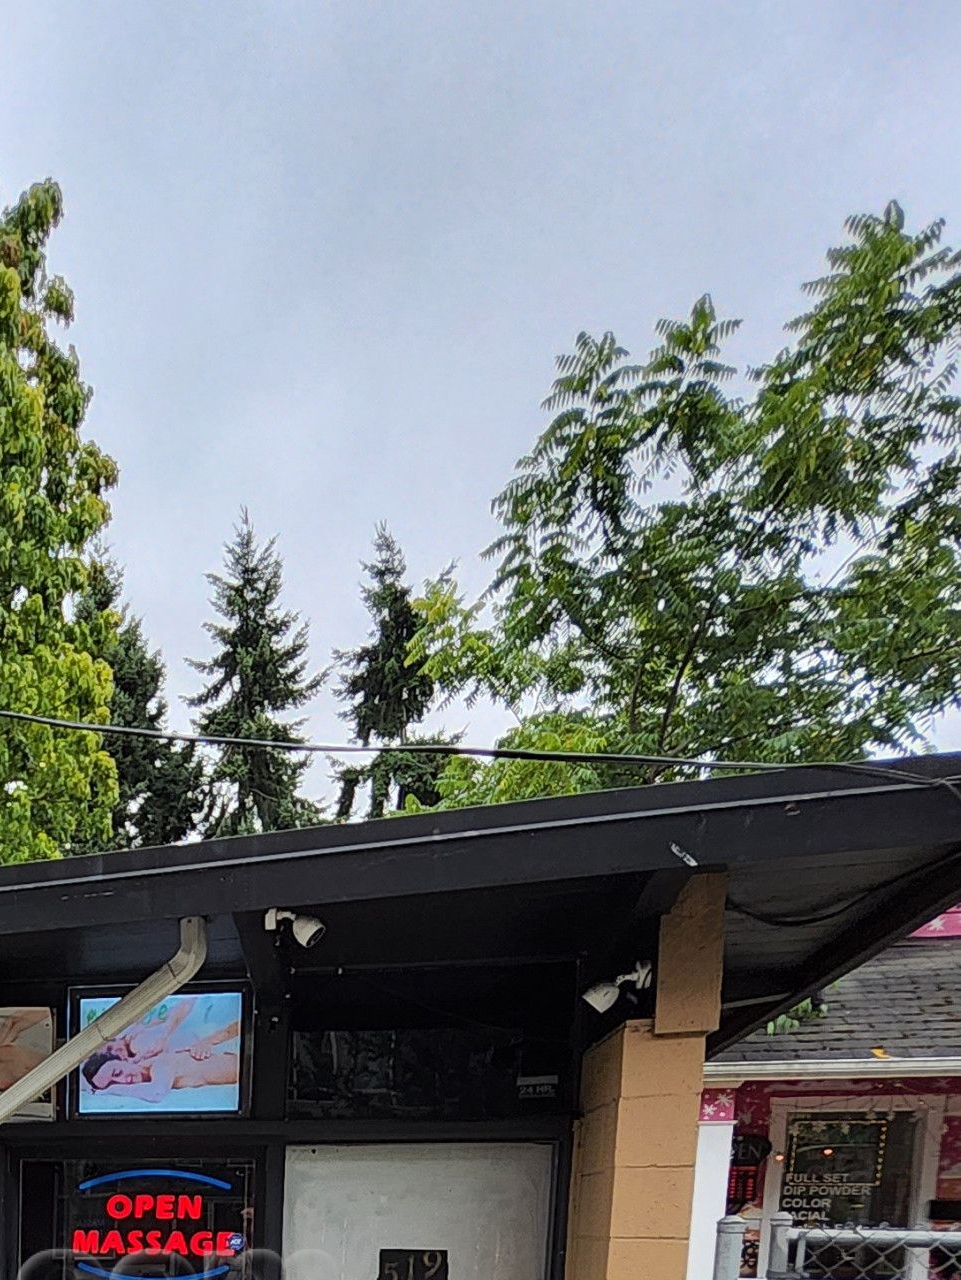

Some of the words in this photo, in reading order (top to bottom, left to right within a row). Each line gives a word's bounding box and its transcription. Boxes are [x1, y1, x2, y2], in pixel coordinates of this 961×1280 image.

[785, 1173, 818, 1183] FULL
[823, 1173, 850, 1183] SET
[783, 1186, 807, 1196] DIP
[809, 1186, 872, 1196] POWDER
[106, 1194, 203, 1220] OPEN
[782, 1198, 833, 1209] COLOR
[72, 1229, 236, 1257] MASSAGE
